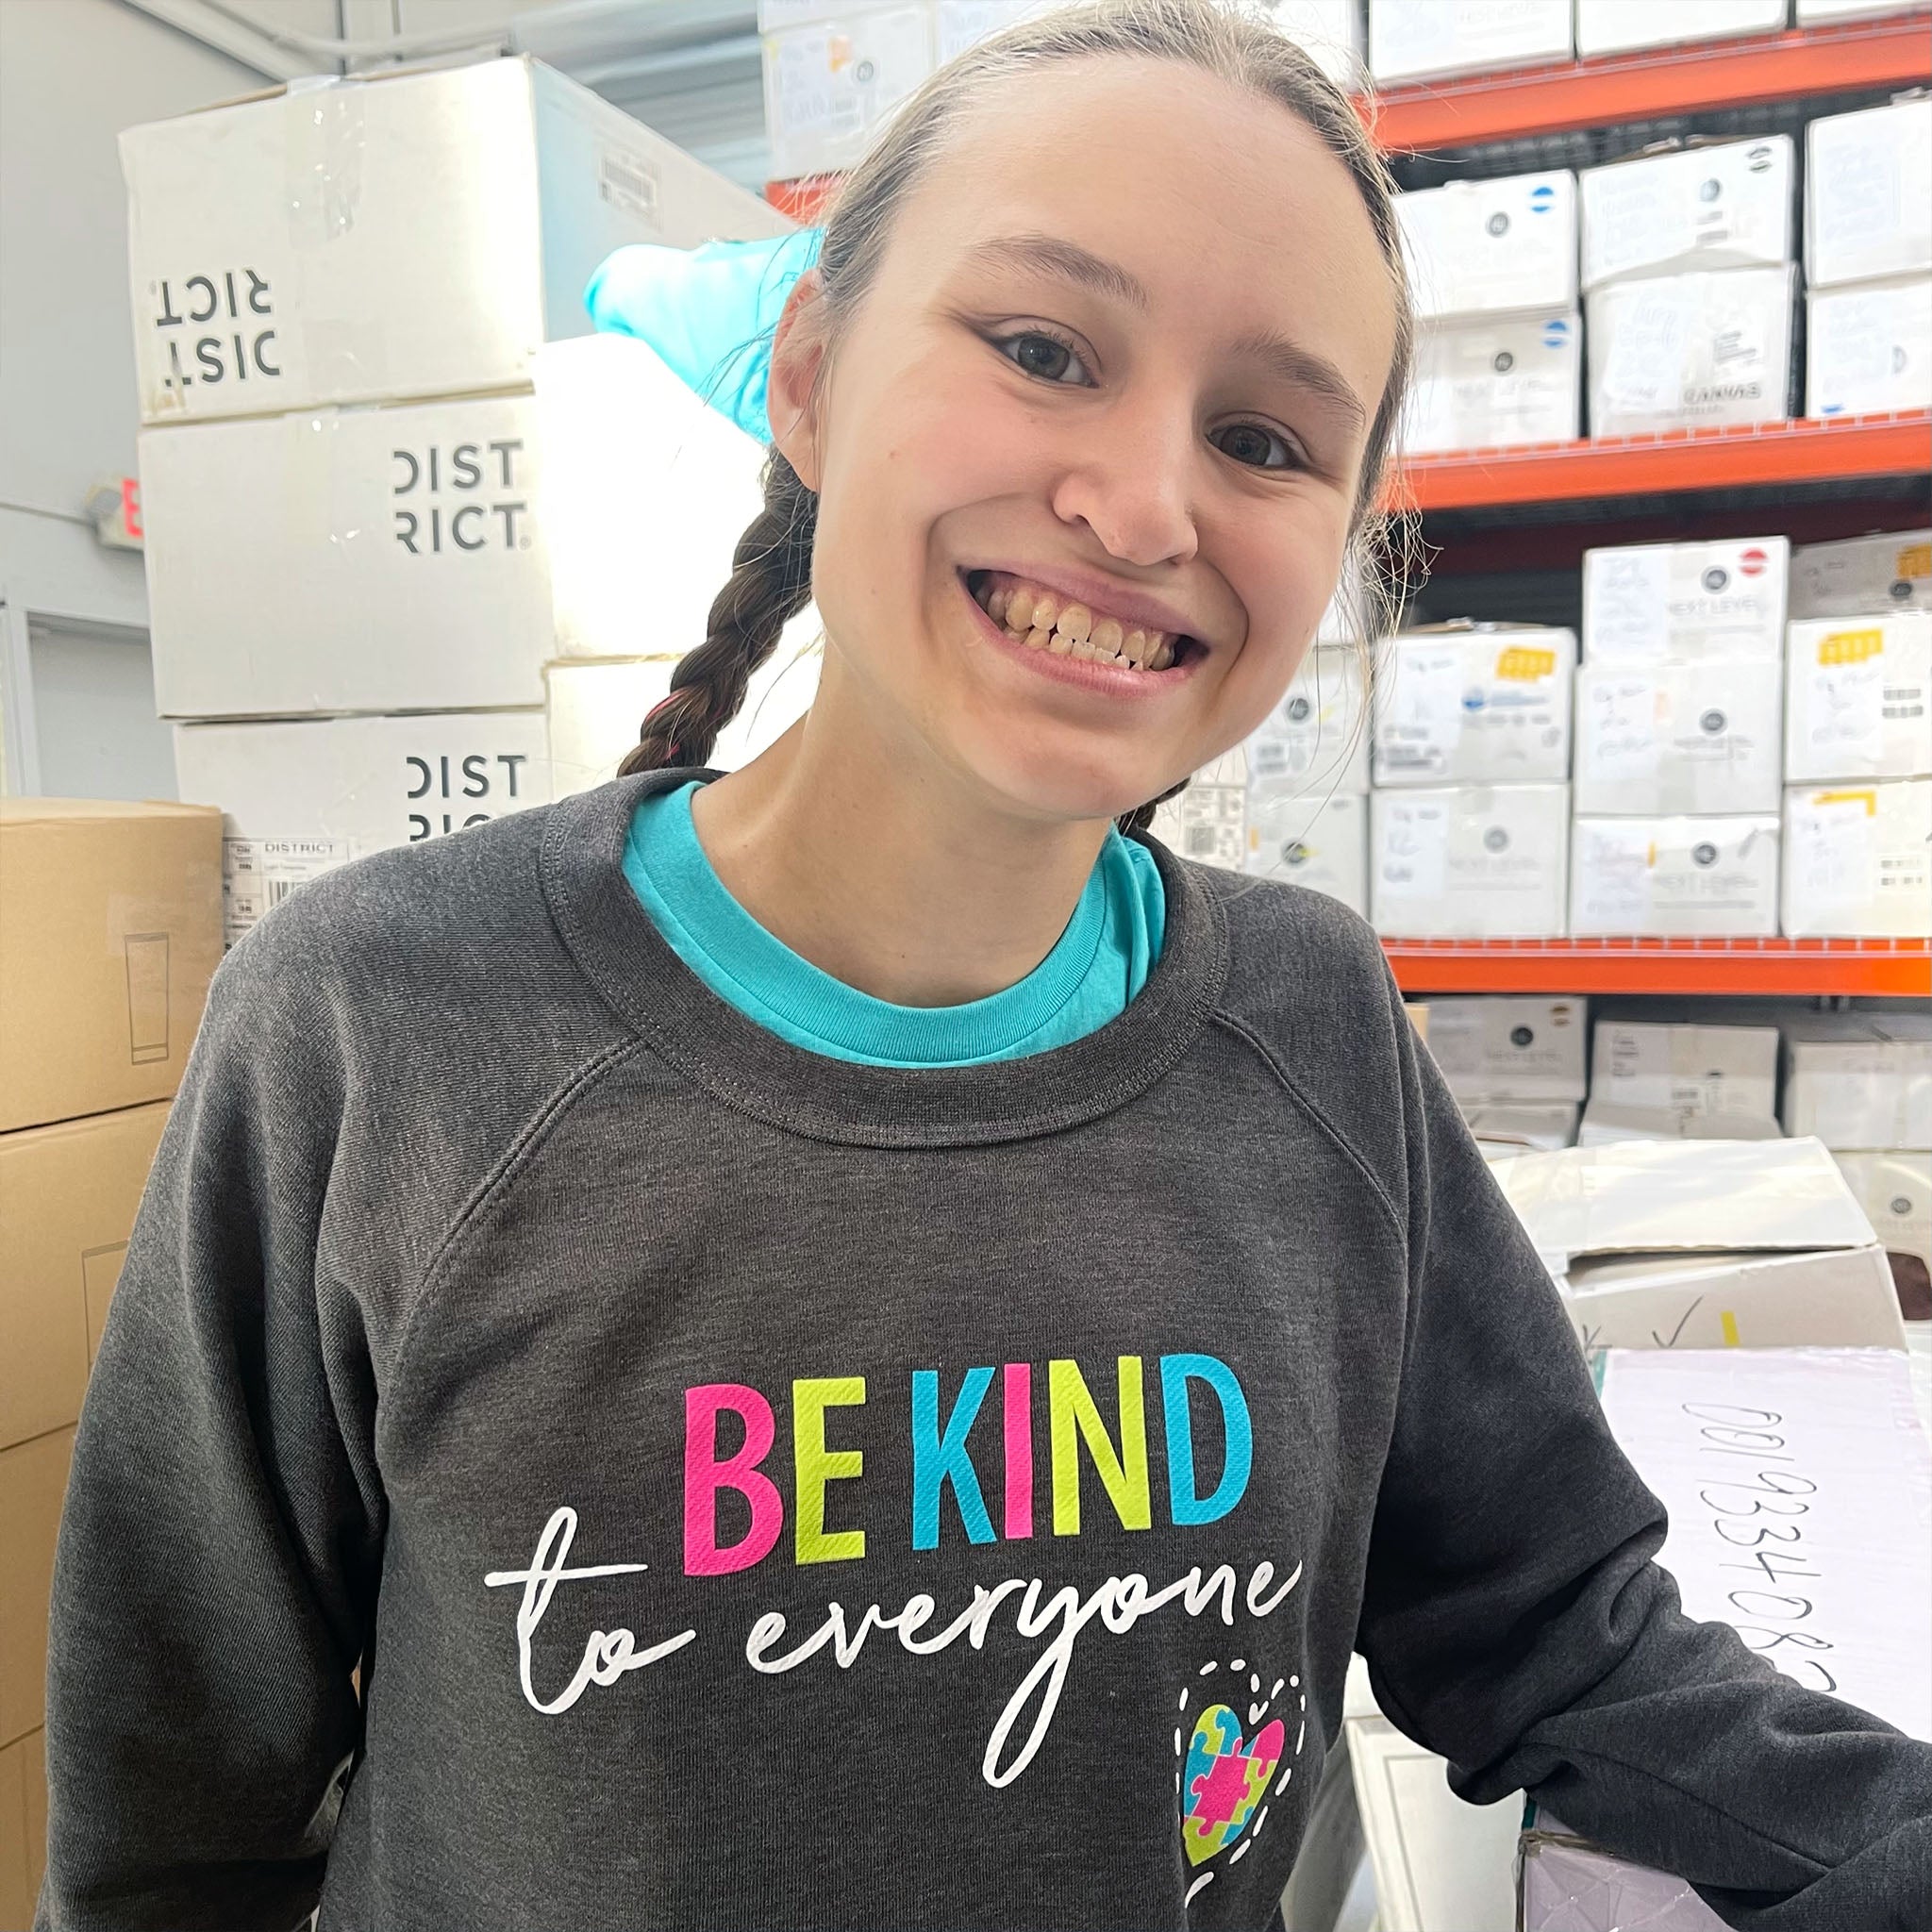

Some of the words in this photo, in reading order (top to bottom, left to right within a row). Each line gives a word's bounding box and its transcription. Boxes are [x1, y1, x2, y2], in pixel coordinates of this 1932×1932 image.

[393, 441, 522, 494] DIST
[406, 755, 526, 799] DIST
[684, 1376, 866, 1576] BE
[911, 1353, 1254, 1551] KIND
[484, 1507, 696, 1715] to
[744, 1559, 1303, 1789] everyone
